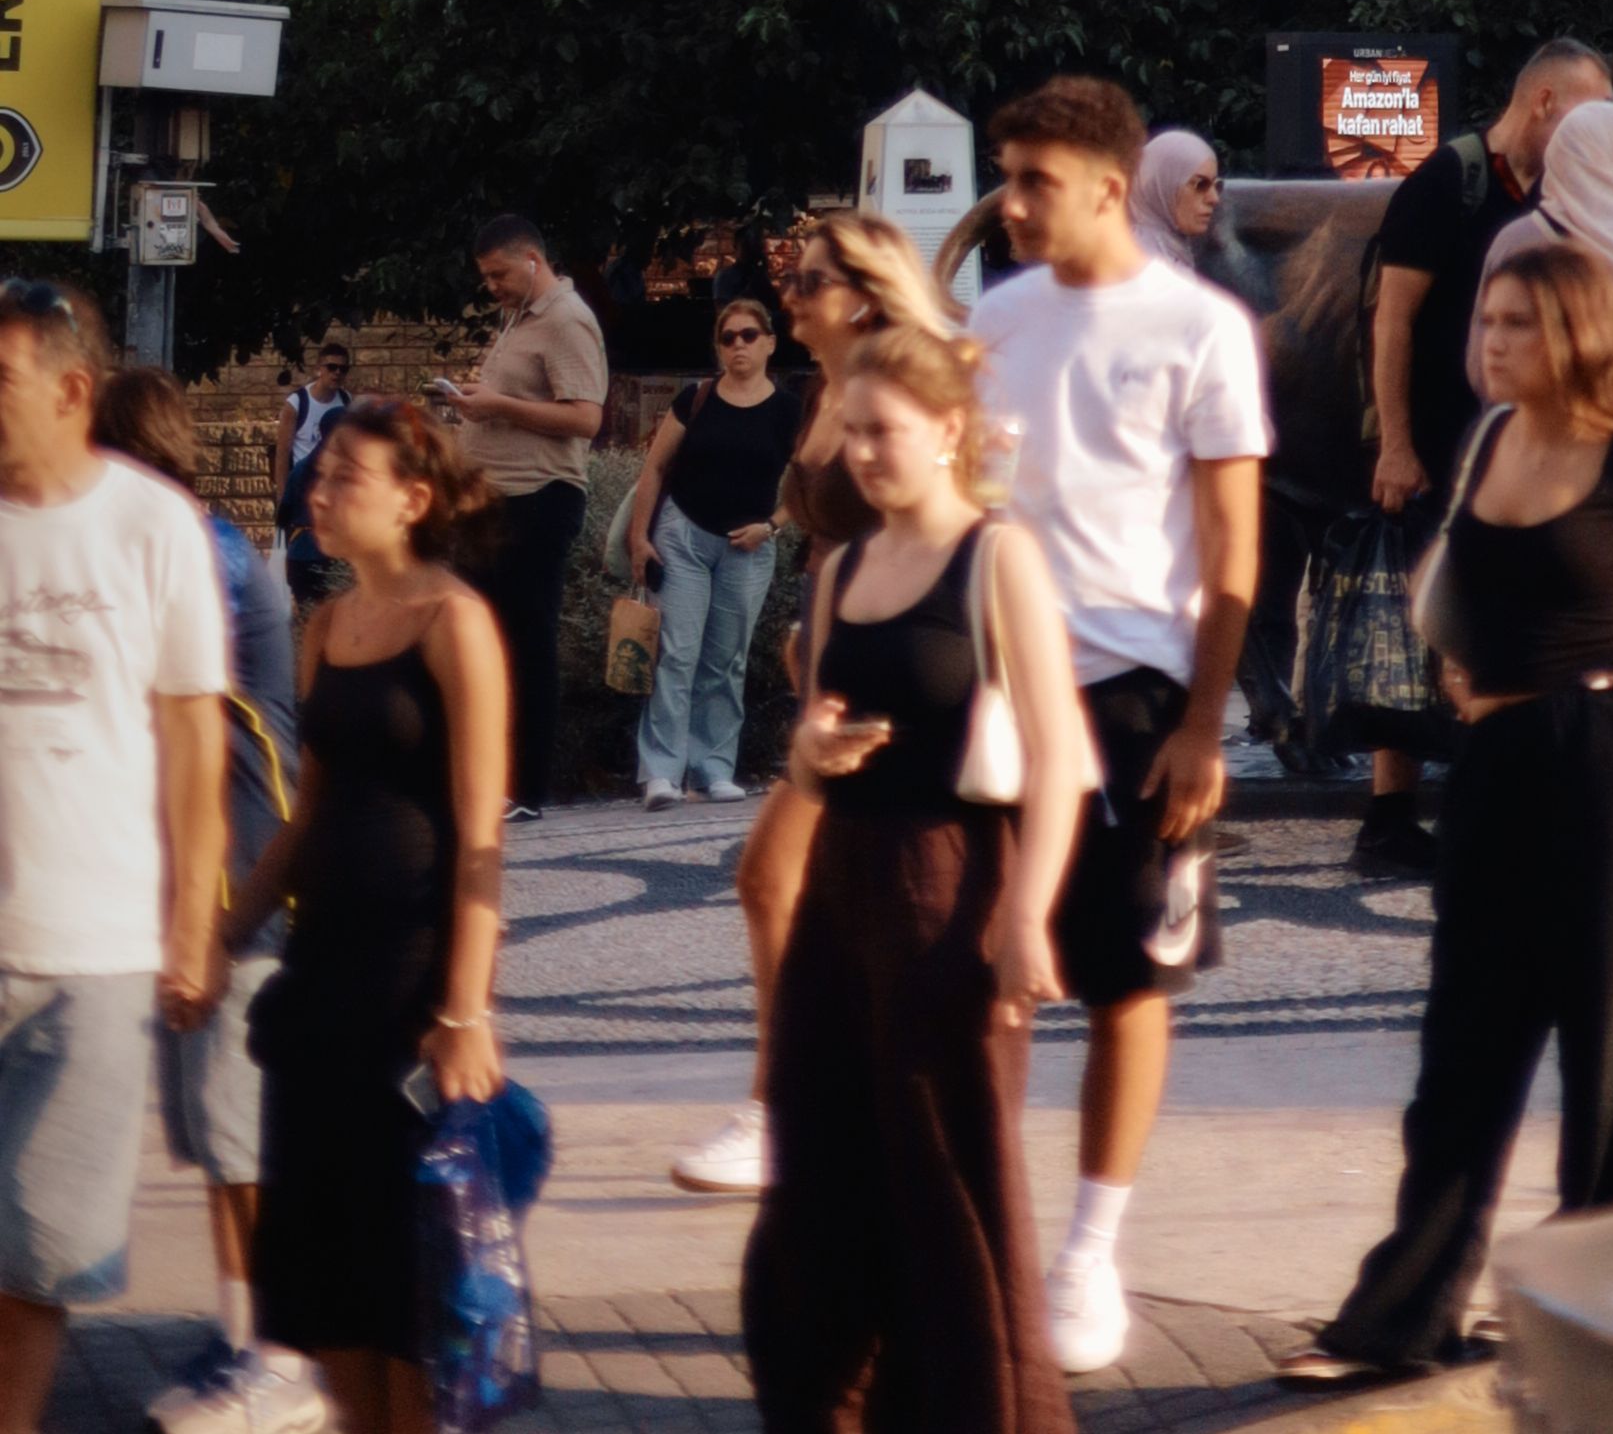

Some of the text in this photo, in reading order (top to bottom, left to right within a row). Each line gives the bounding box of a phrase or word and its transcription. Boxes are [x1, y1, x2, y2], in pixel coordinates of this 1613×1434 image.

[1341, 86, 1420, 109] Amazon'la
[1337, 113, 1424, 136] kafan rahat
